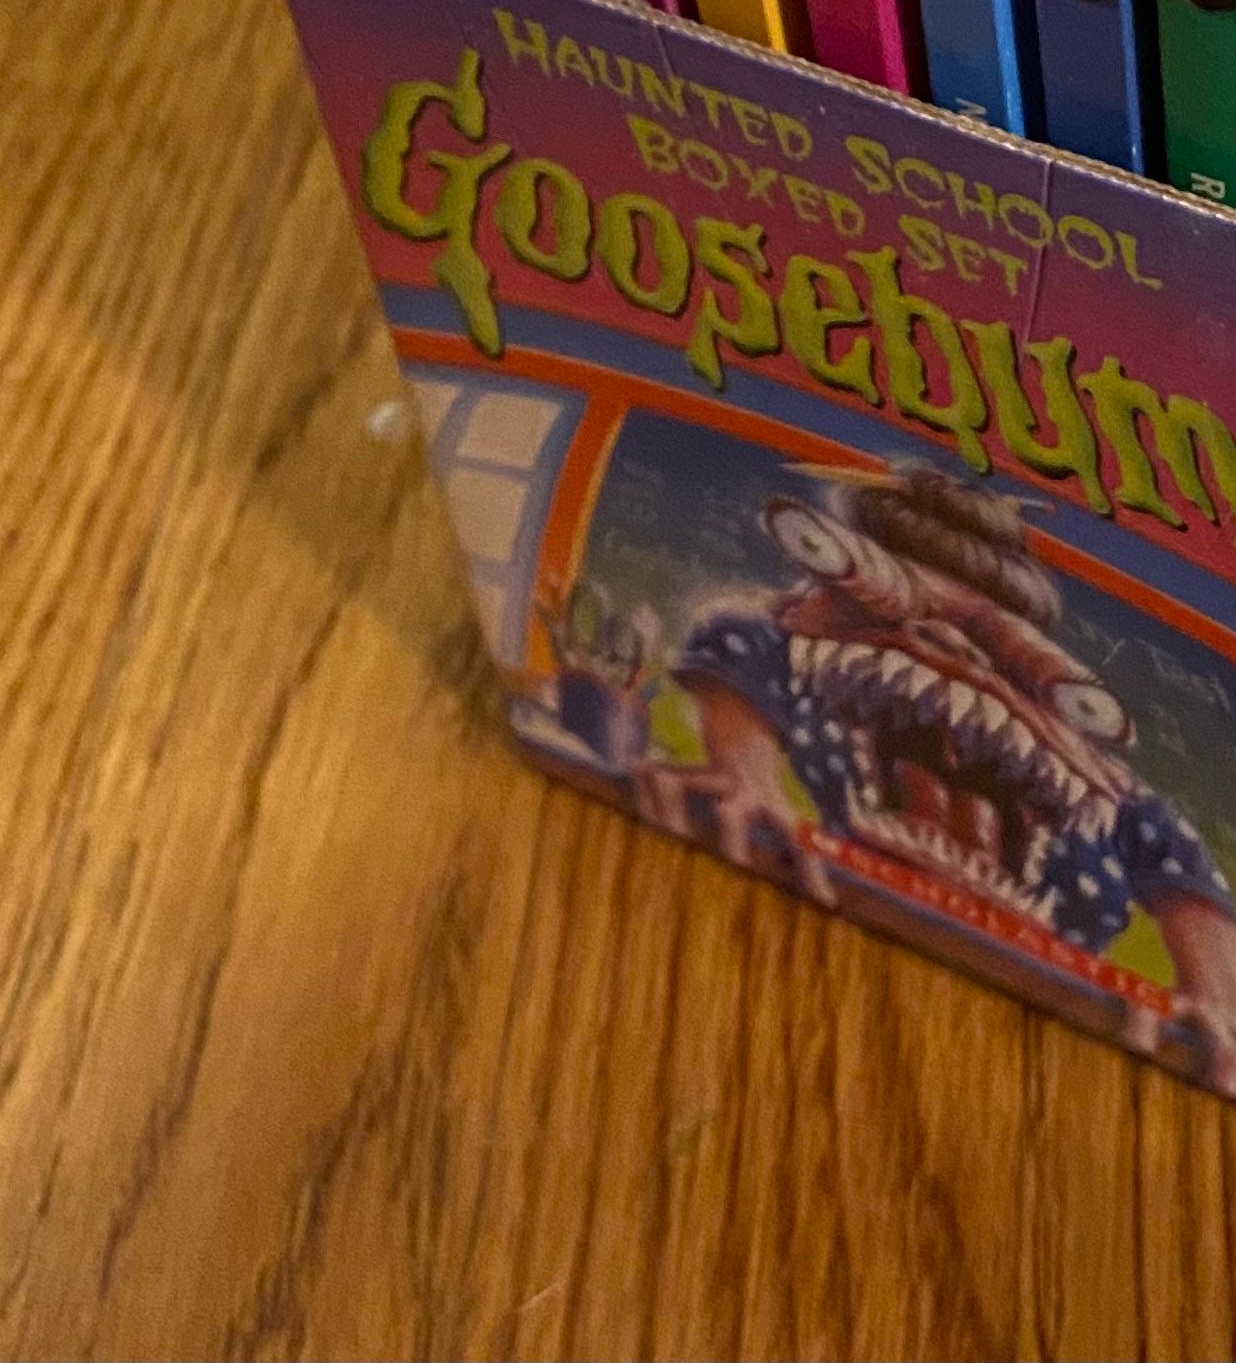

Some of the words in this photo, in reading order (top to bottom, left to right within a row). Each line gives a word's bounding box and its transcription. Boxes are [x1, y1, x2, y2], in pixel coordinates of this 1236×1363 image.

[494, 9, 812, 160] HAUNTED
[846, 135, 1163, 289] SCHOOL
[628, 118, 865, 236] BOXED
[898, 214, 1030, 297] SET
